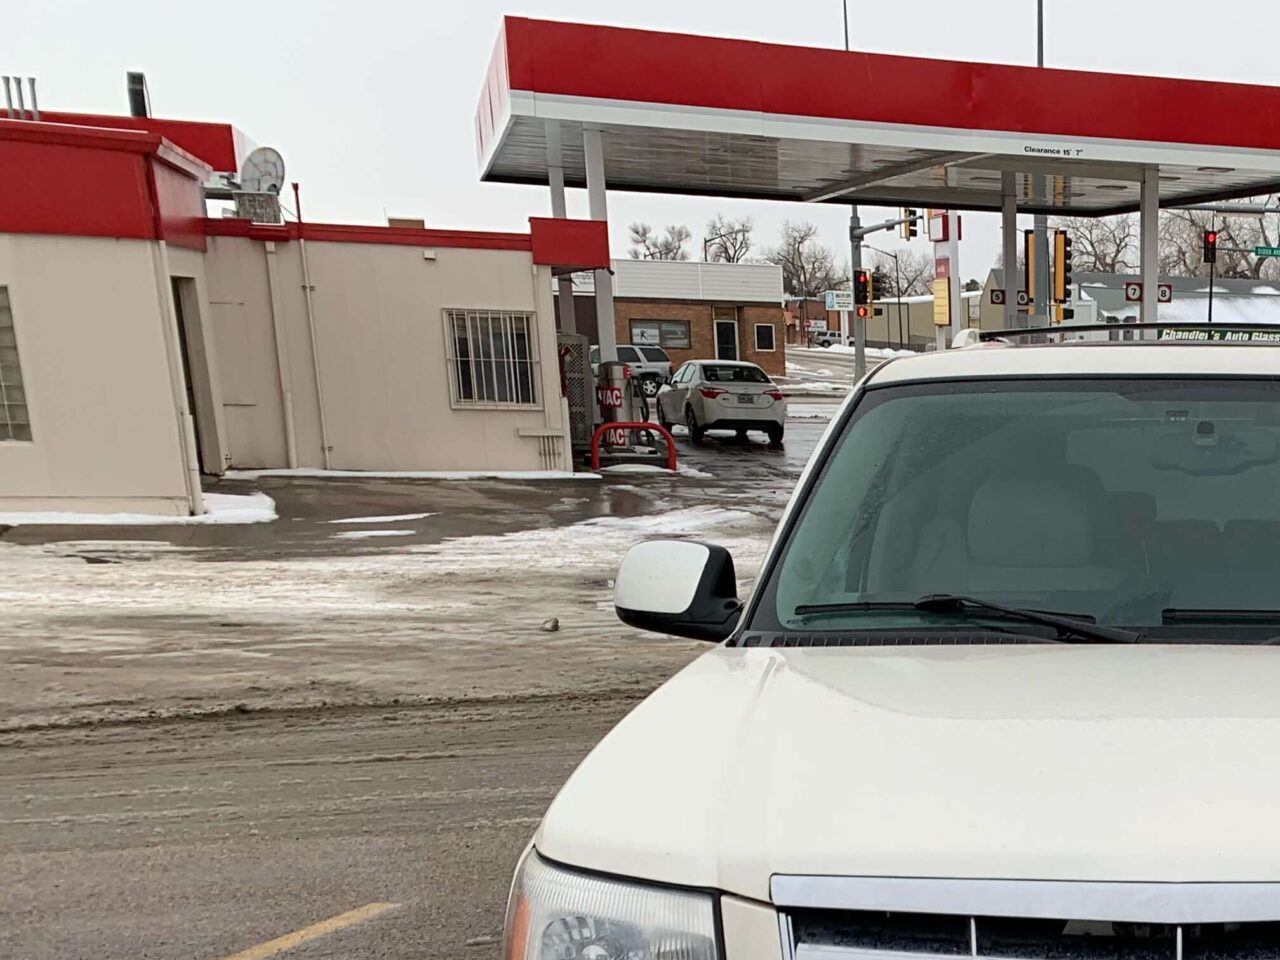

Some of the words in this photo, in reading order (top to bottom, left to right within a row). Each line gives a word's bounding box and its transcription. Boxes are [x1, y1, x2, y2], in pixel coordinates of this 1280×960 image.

[1024, 145, 1061, 155] Clearance
[1225, 331, 1250, 341] Auto
[598, 389, 621, 406] VAC
